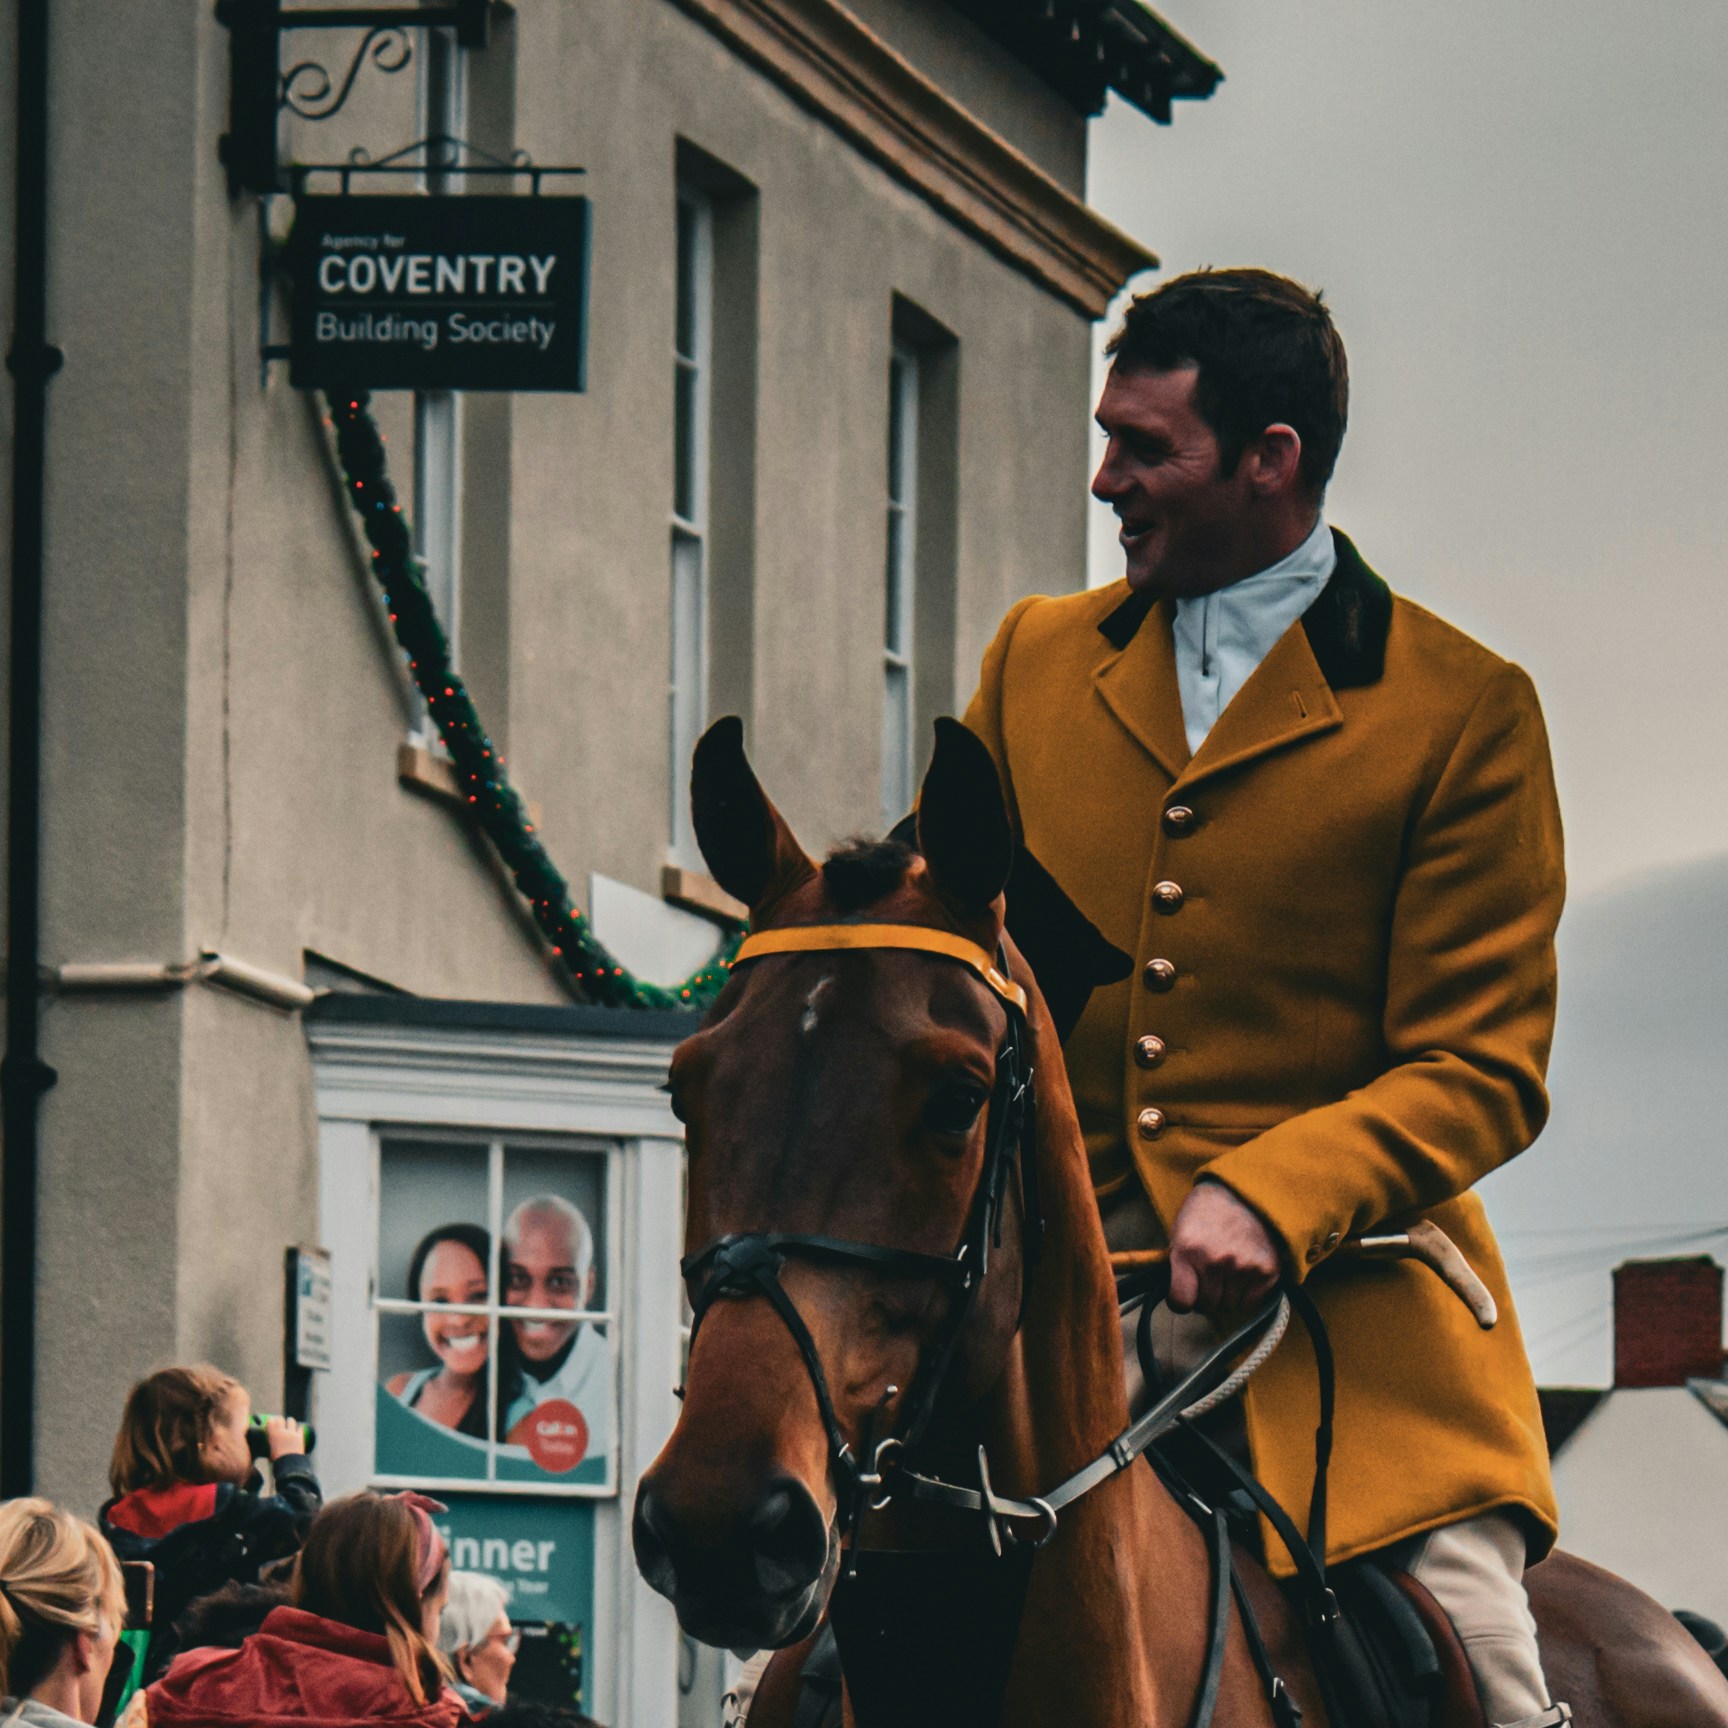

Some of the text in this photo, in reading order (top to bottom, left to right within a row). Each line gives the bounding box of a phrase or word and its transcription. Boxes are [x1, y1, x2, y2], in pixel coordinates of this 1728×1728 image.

[318, 254, 556, 295] COVENTRY
[316, 311, 556, 351] Building Society
[441, 1526, 557, 1572] inner
